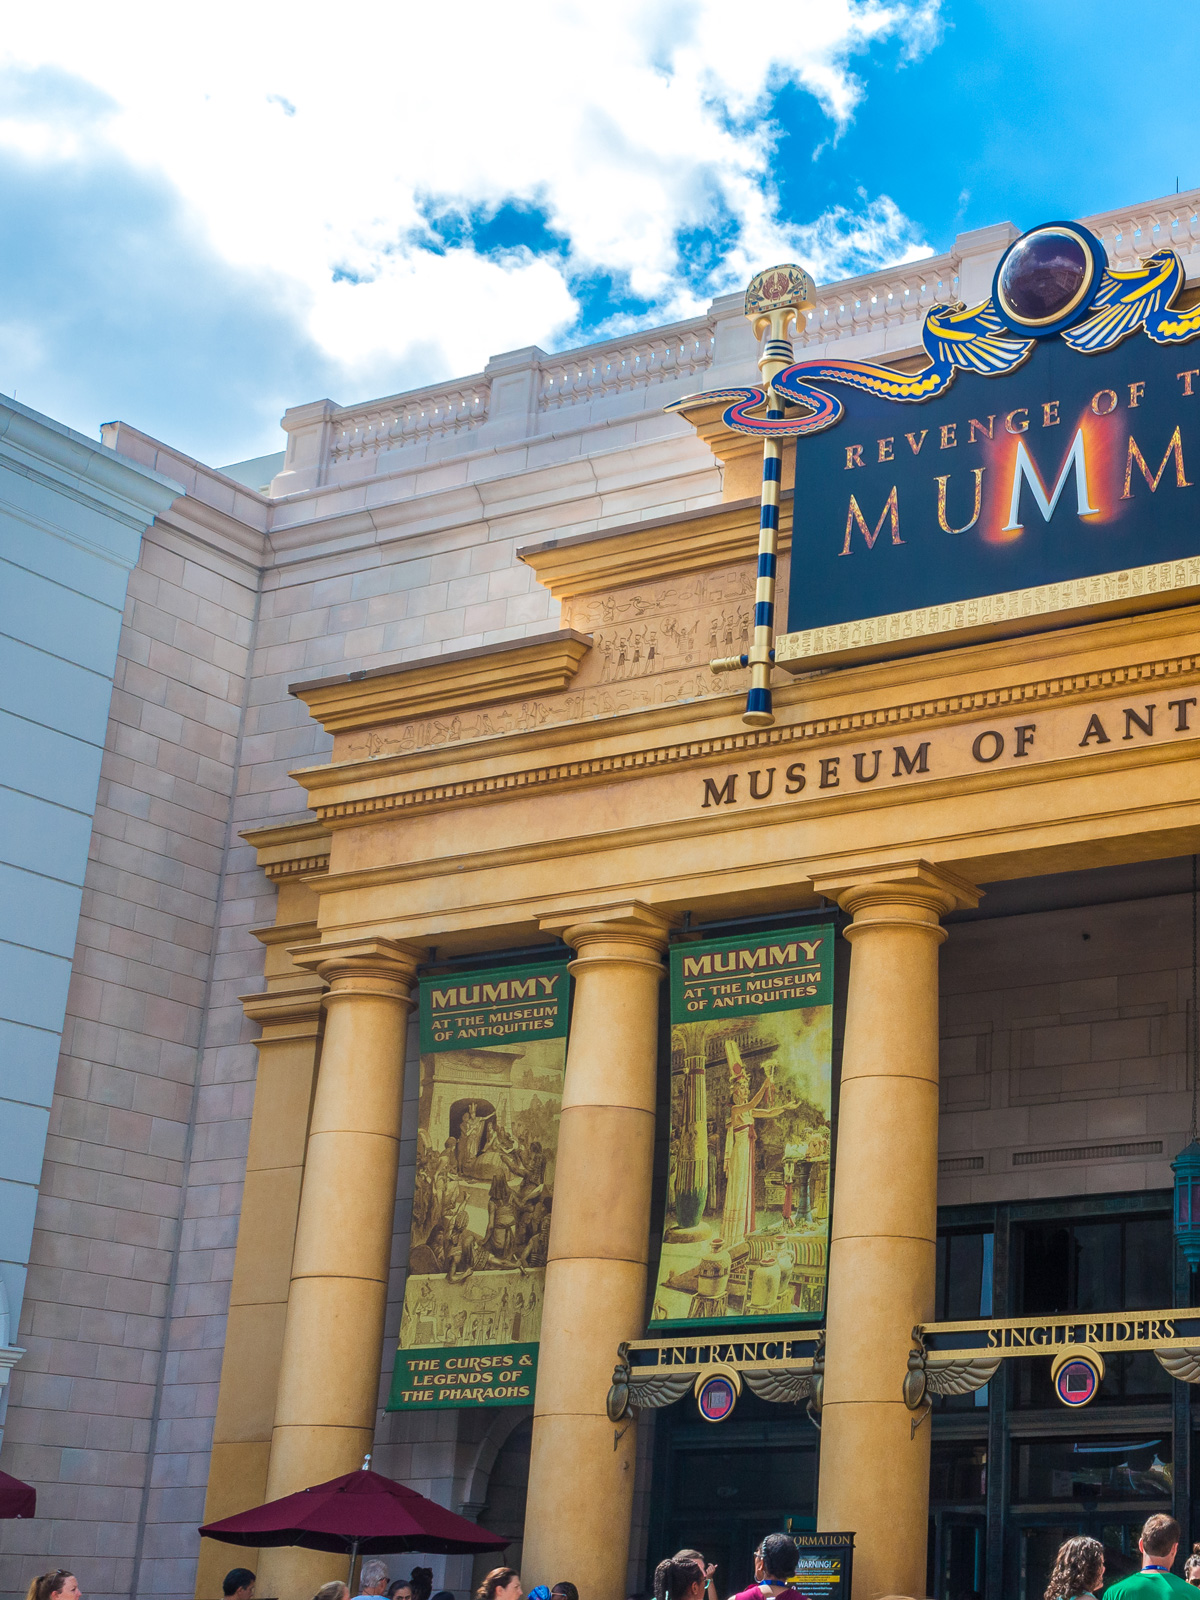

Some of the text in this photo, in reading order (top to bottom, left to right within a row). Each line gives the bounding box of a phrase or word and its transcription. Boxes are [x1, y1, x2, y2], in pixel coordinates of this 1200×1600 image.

[844, 400, 1062, 470] REVENGE
[1091, 380, 1147, 418] OF
[701, 741, 931, 808] MUSEUM
[972, 723, 1036, 763] OF
[683, 938, 823, 978] MUMMY
[431, 974, 560, 1009] MUMMY
[683, 971, 821, 999] AT THE MUSEUM
[687, 985, 818, 1011] OF ANTIQUITIES
[431, 1005, 558, 1030] AT THE MUSEUM
[434, 1018, 554, 1042] OF ANTIQUITIES
[986, 1319, 1176, 1349] SINGLE RIDERS
[407, 1354, 533, 1371] THE CURSES &
[657, 1340, 794, 1367] ENTRANCE
[413, 1370, 522, 1386] LEGENDS OF
[401, 1385, 530, 1402] THE PHARAOHS
[793, 1535, 851, 1546] ORMATION
